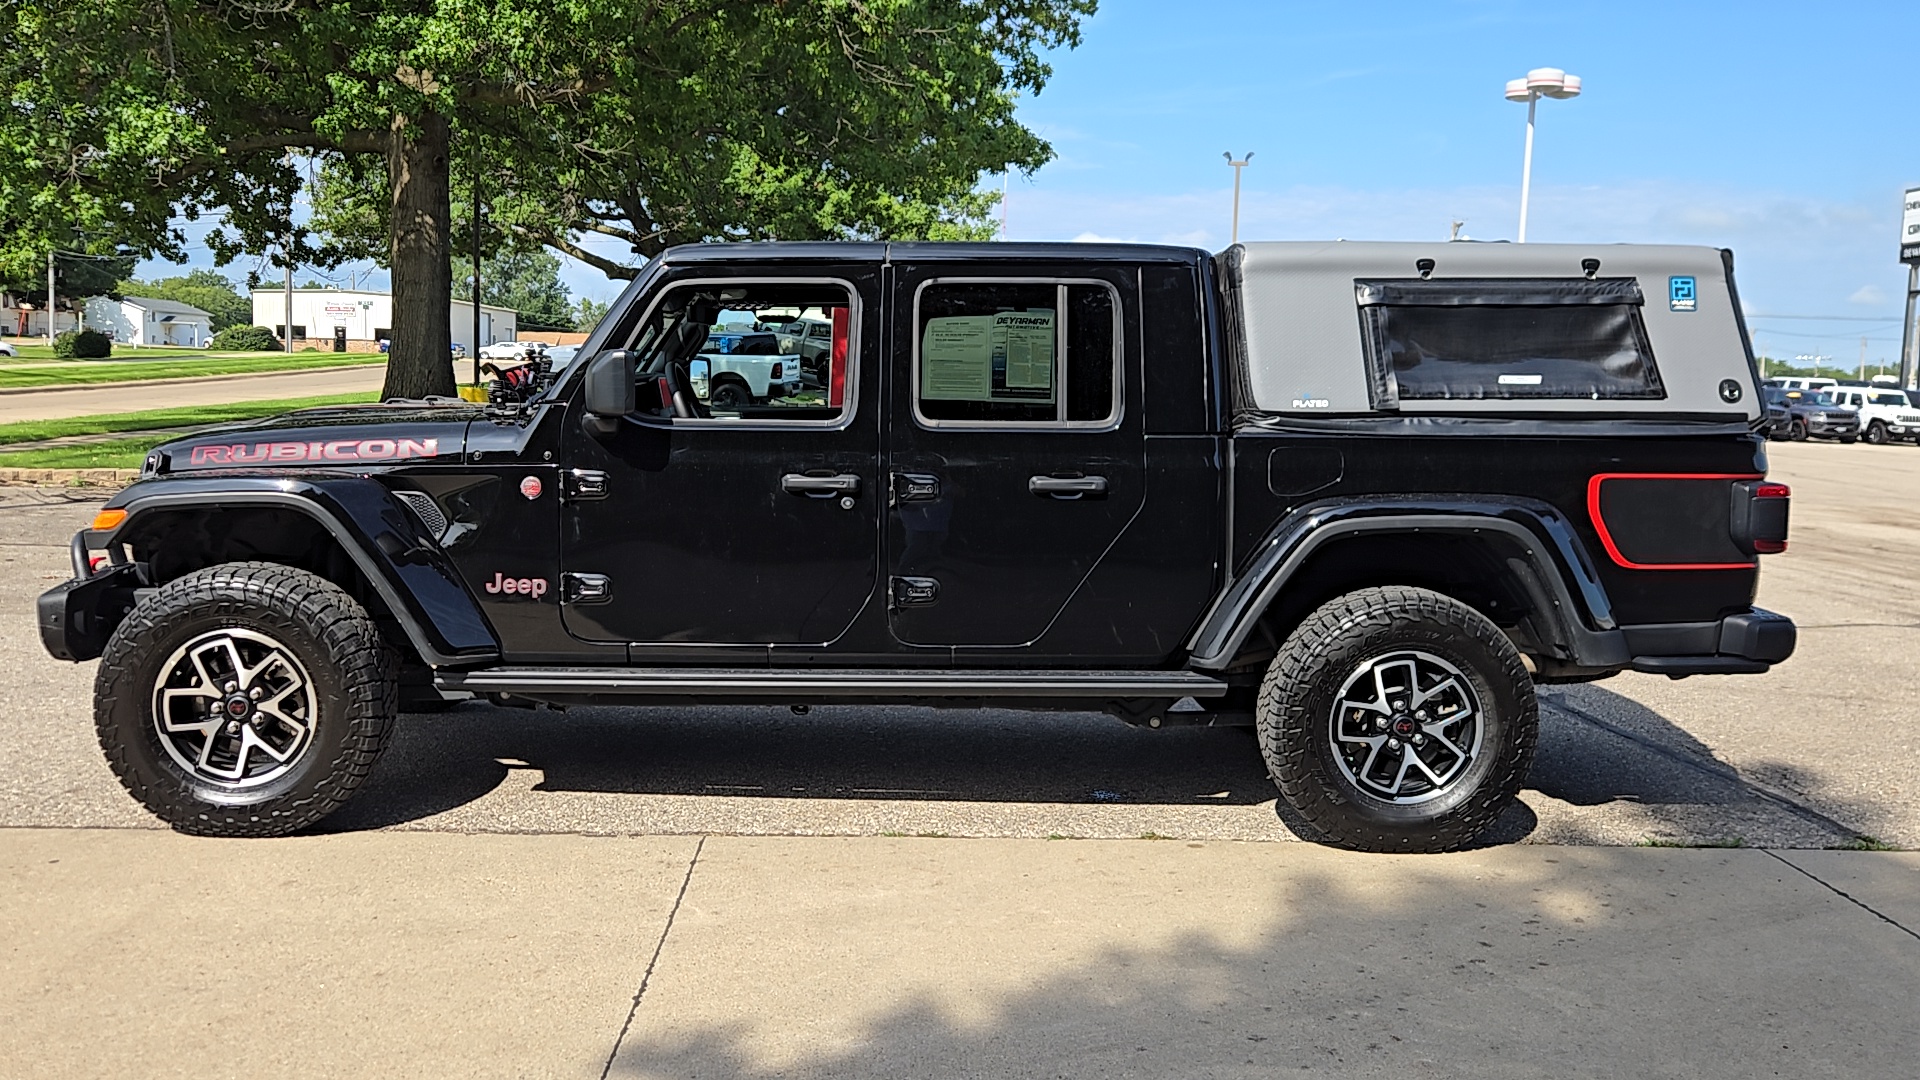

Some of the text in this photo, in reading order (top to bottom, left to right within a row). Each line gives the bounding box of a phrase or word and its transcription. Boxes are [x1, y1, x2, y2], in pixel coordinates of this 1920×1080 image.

[996, 317, 1050, 325] DEYARMAN
[190, 438, 439, 466] RUBICON
[485, 571, 548, 599] Jeep
